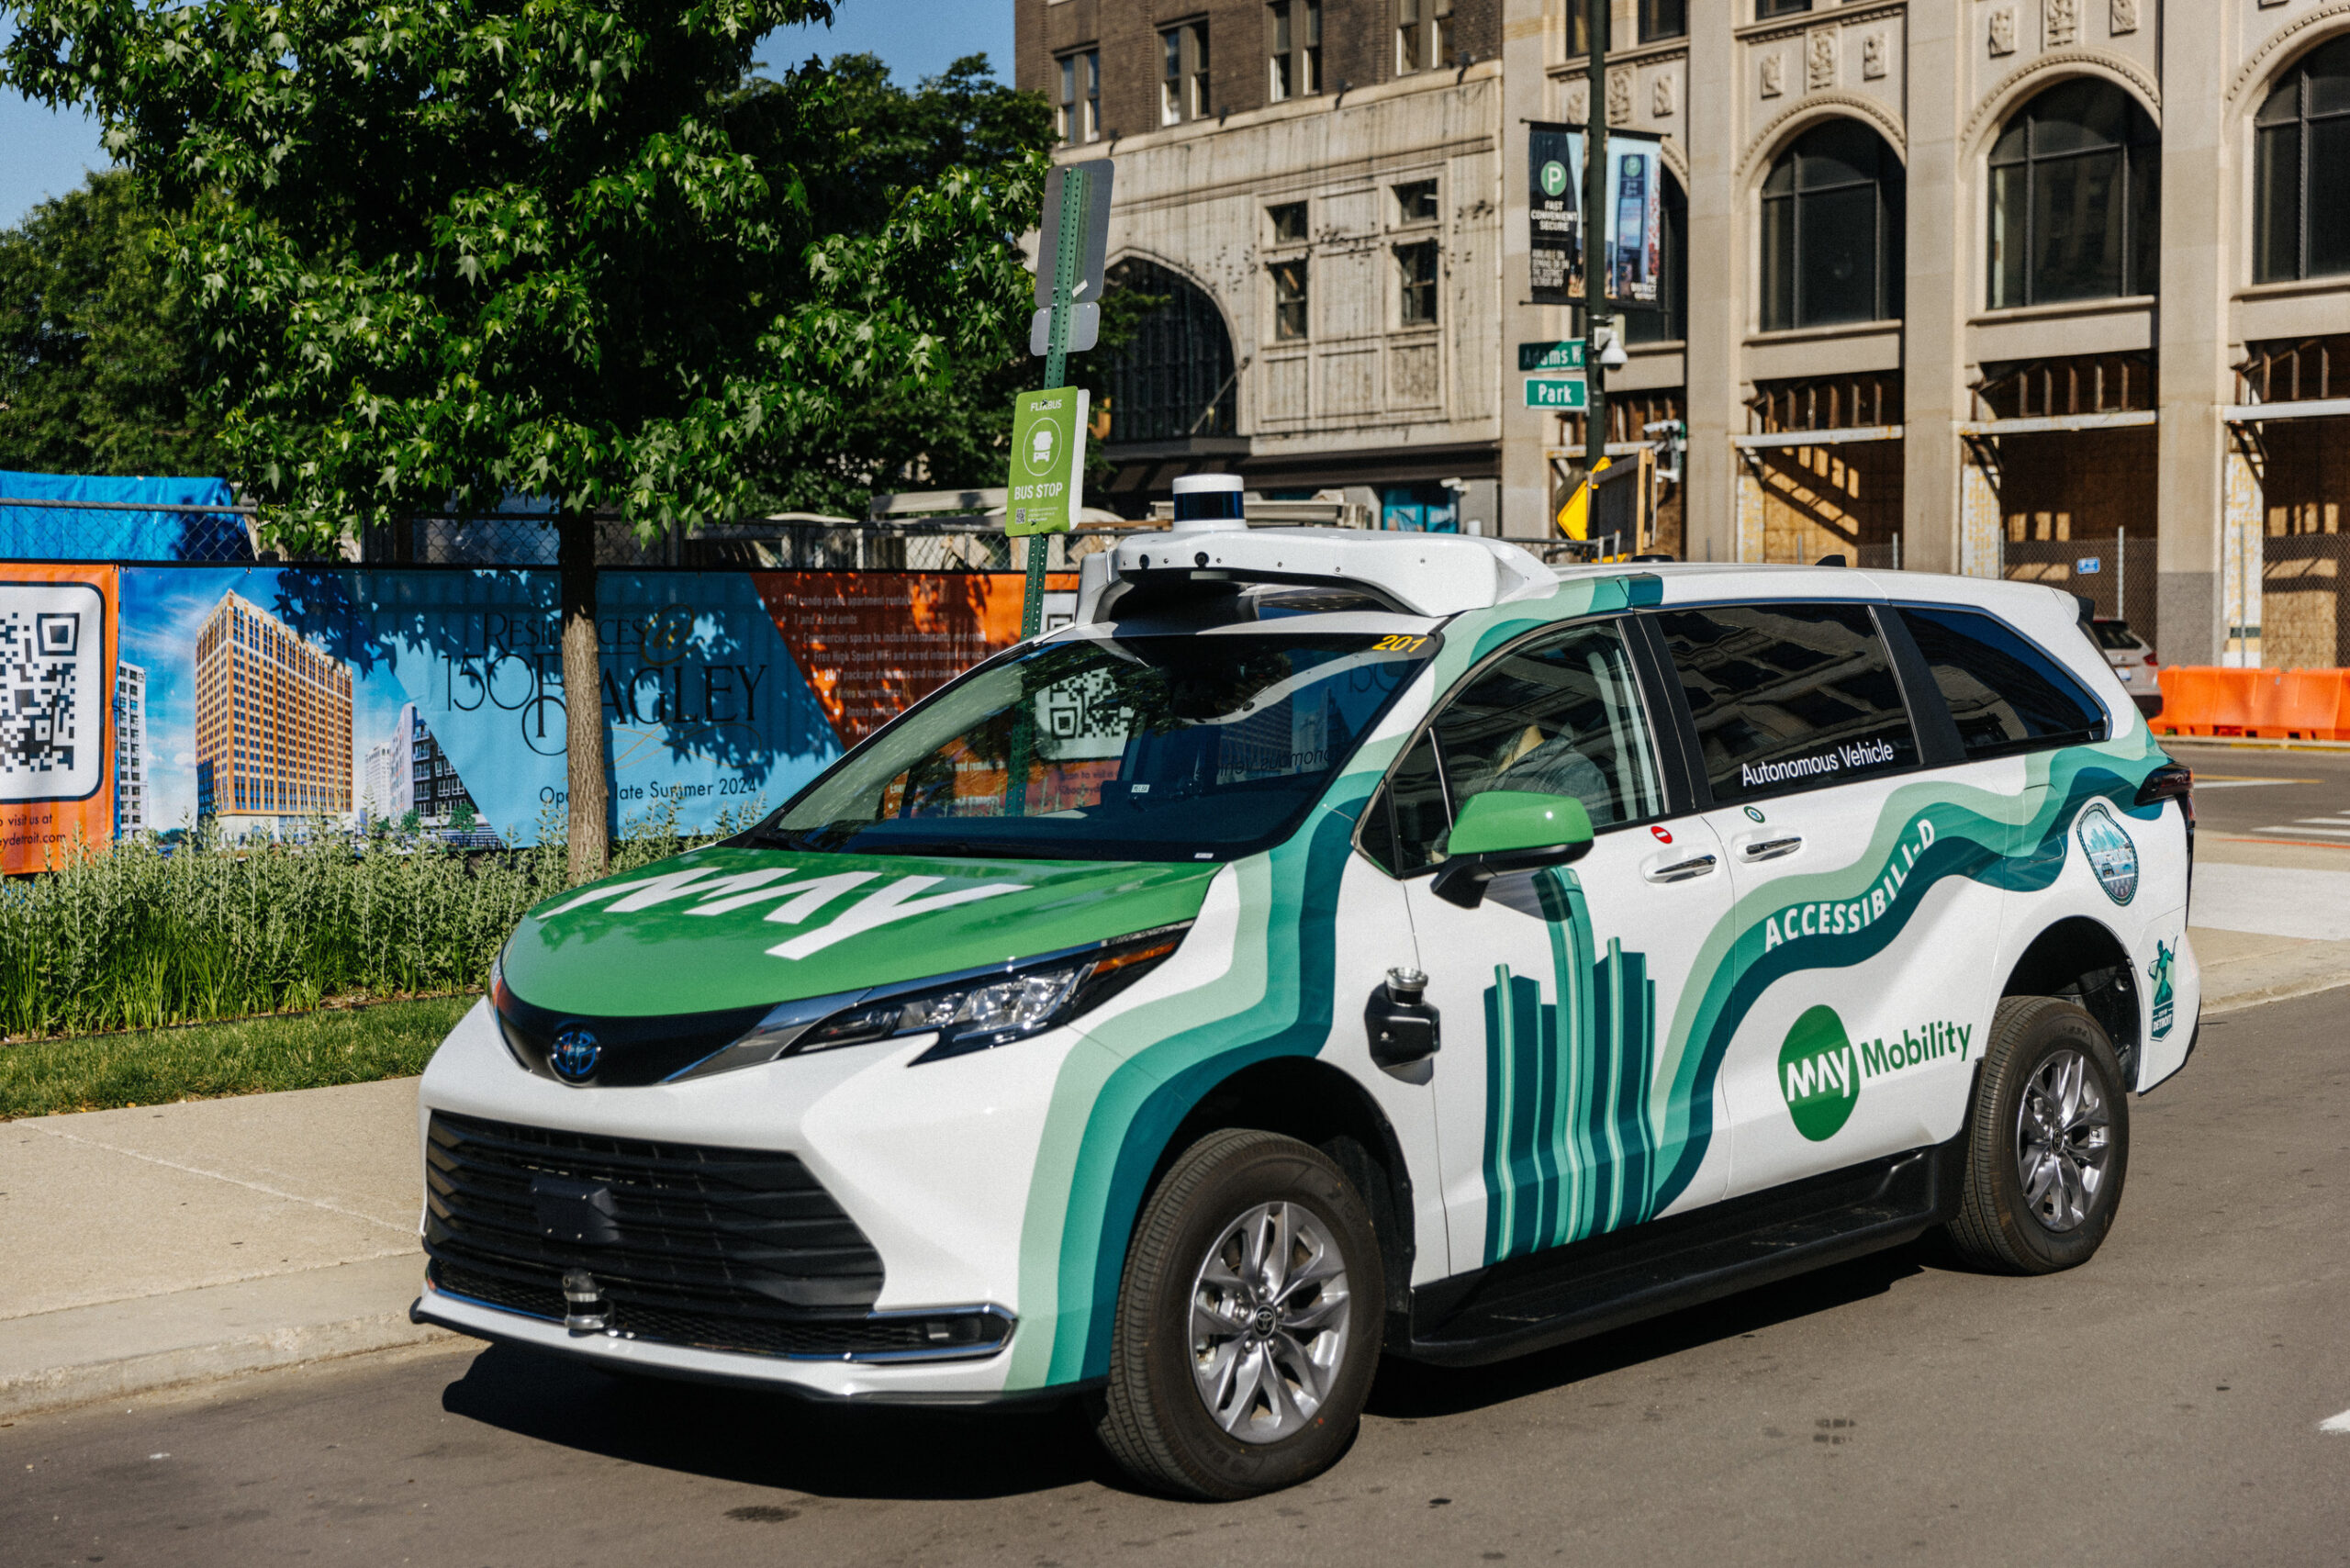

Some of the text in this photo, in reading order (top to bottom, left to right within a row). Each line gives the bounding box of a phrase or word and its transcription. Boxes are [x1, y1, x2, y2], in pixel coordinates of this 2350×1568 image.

[1548, 166, 1562, 191] P
[1530, 209, 1578, 222] CONVENIENT
[1539, 220, 1570, 231] SECURE
[1538, 383, 1572, 404] Park
[1014, 481, 1063, 500] BUS STOP
[800, 614, 813, 624] and
[483, 611, 644, 654] RESICES
[1371, 634, 1427, 653] 201
[814, 650, 831, 661] Free
[851, 649, 875, 663] Speed
[442, 654, 534, 711] 150
[1741, 738, 1894, 787] Autonomous Vehicle
[614, 778, 757, 801] late Summer 2024
[7, 813, 28, 827] visit
[29, 815, 39, 825] us
[41, 812, 53, 824] at
[1764, 818, 1936, 954] ACCESSIBILI-D
[2153, 1014, 2173, 1032] DETROIT
[1860, 1020, 1973, 1079] Mobility
